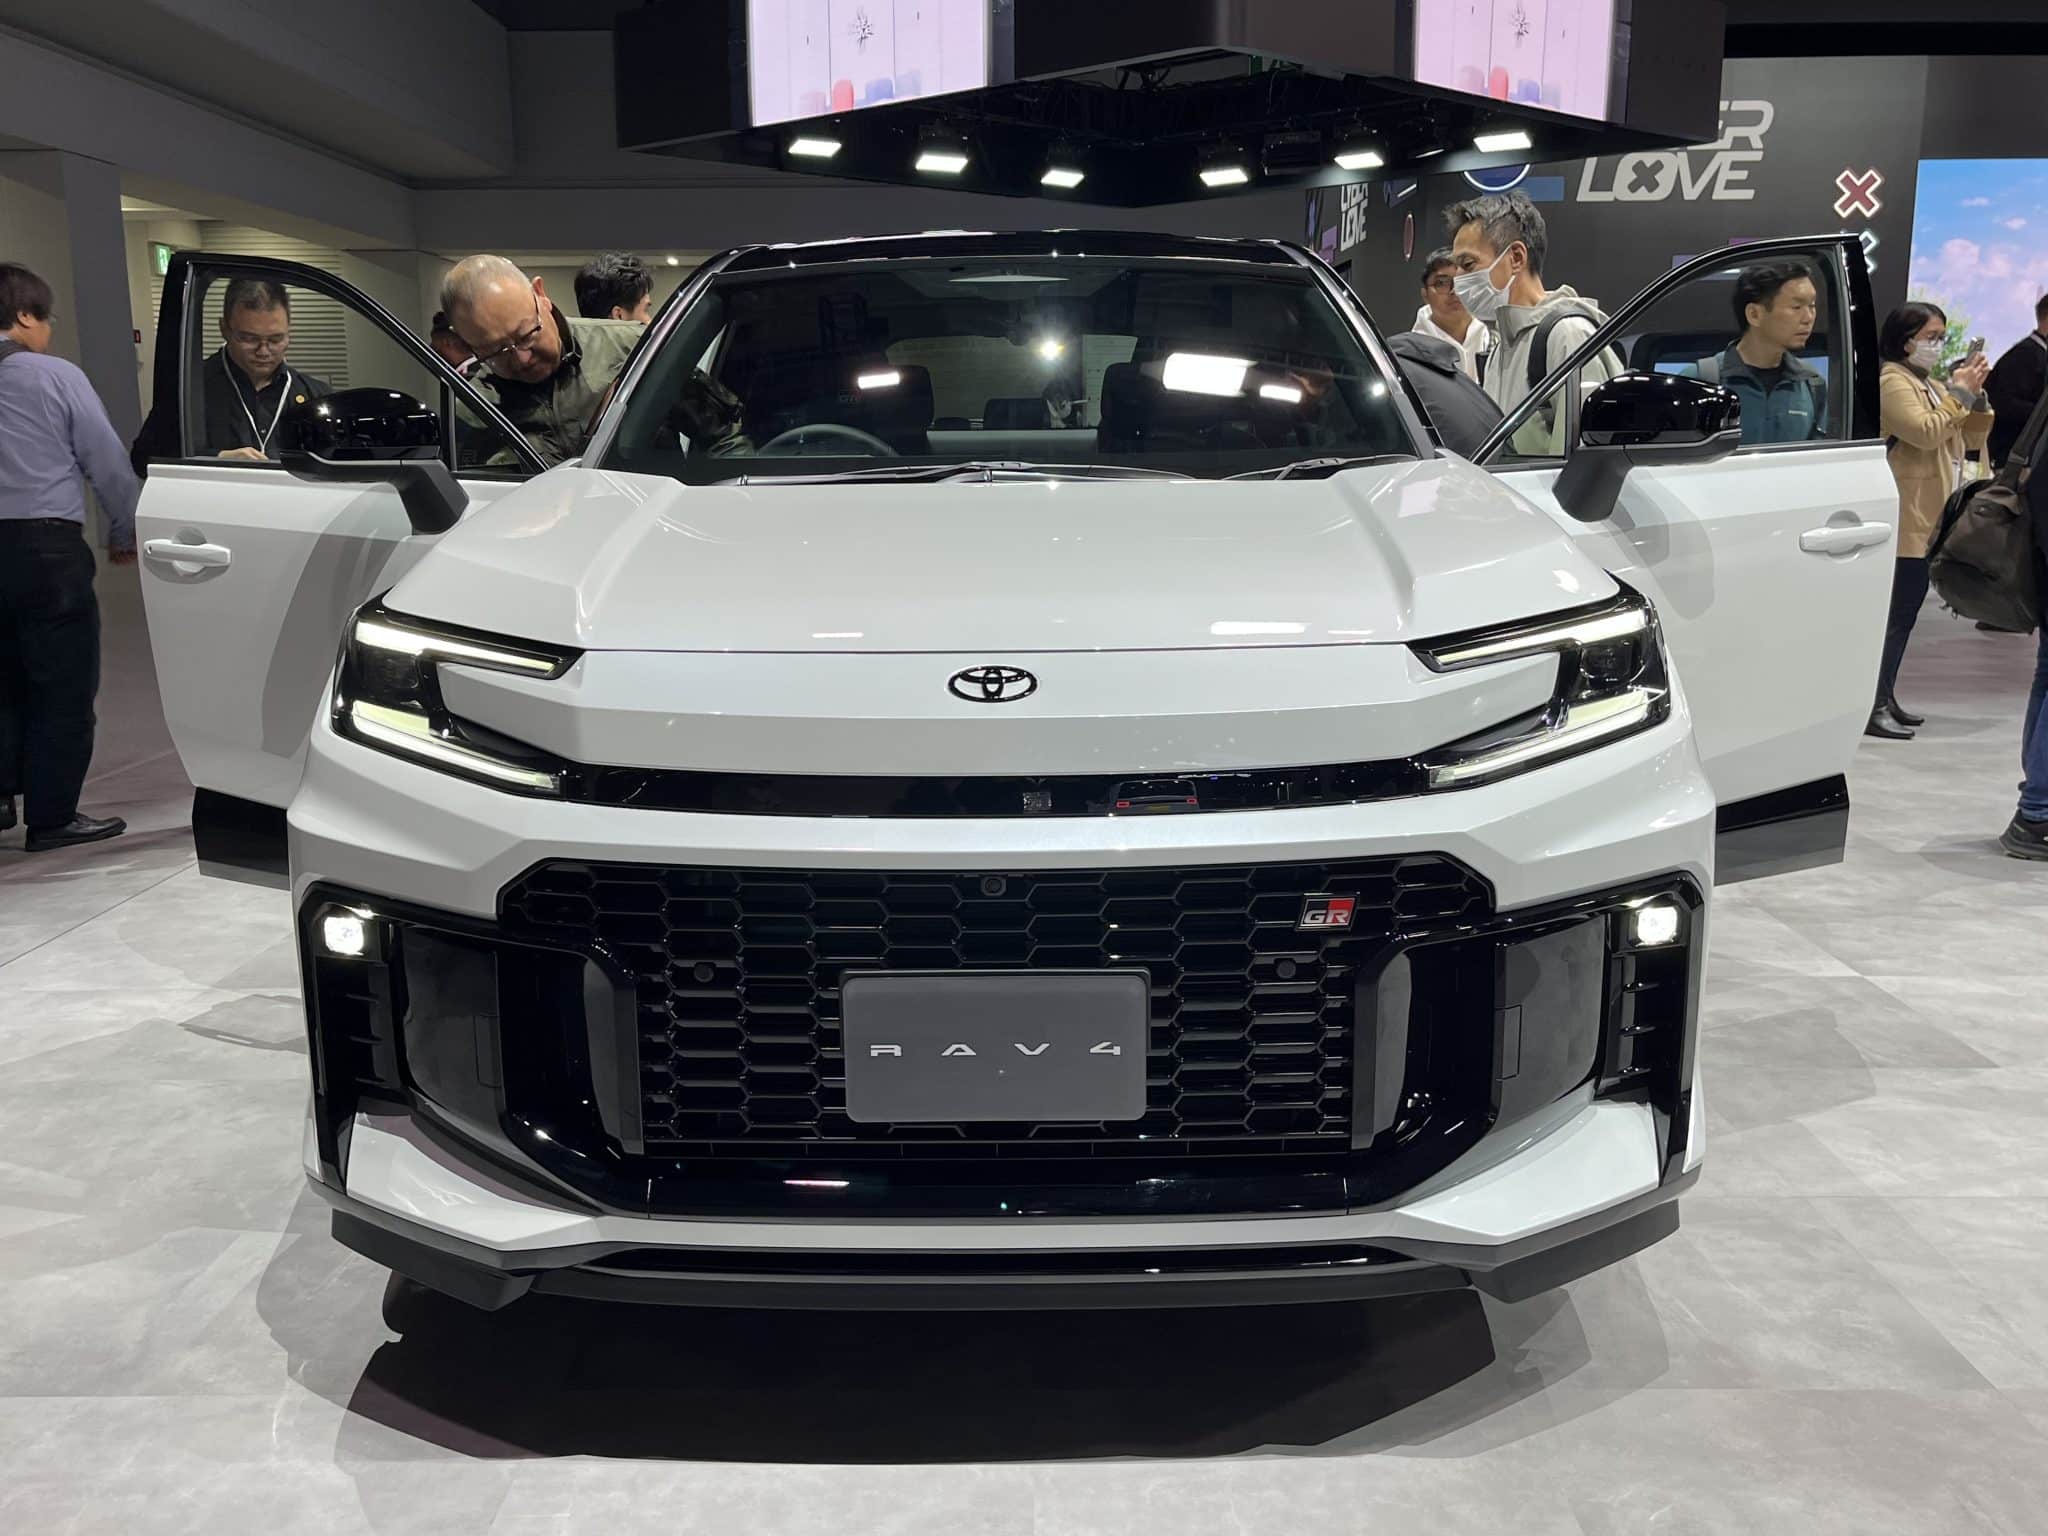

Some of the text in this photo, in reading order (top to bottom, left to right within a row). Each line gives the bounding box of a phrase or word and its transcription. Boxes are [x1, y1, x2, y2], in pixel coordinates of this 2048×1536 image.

[1576, 151, 1764, 202] LOVE
[1340, 198, 1369, 252] LOVE
[1303, 909, 1350, 924] GR
